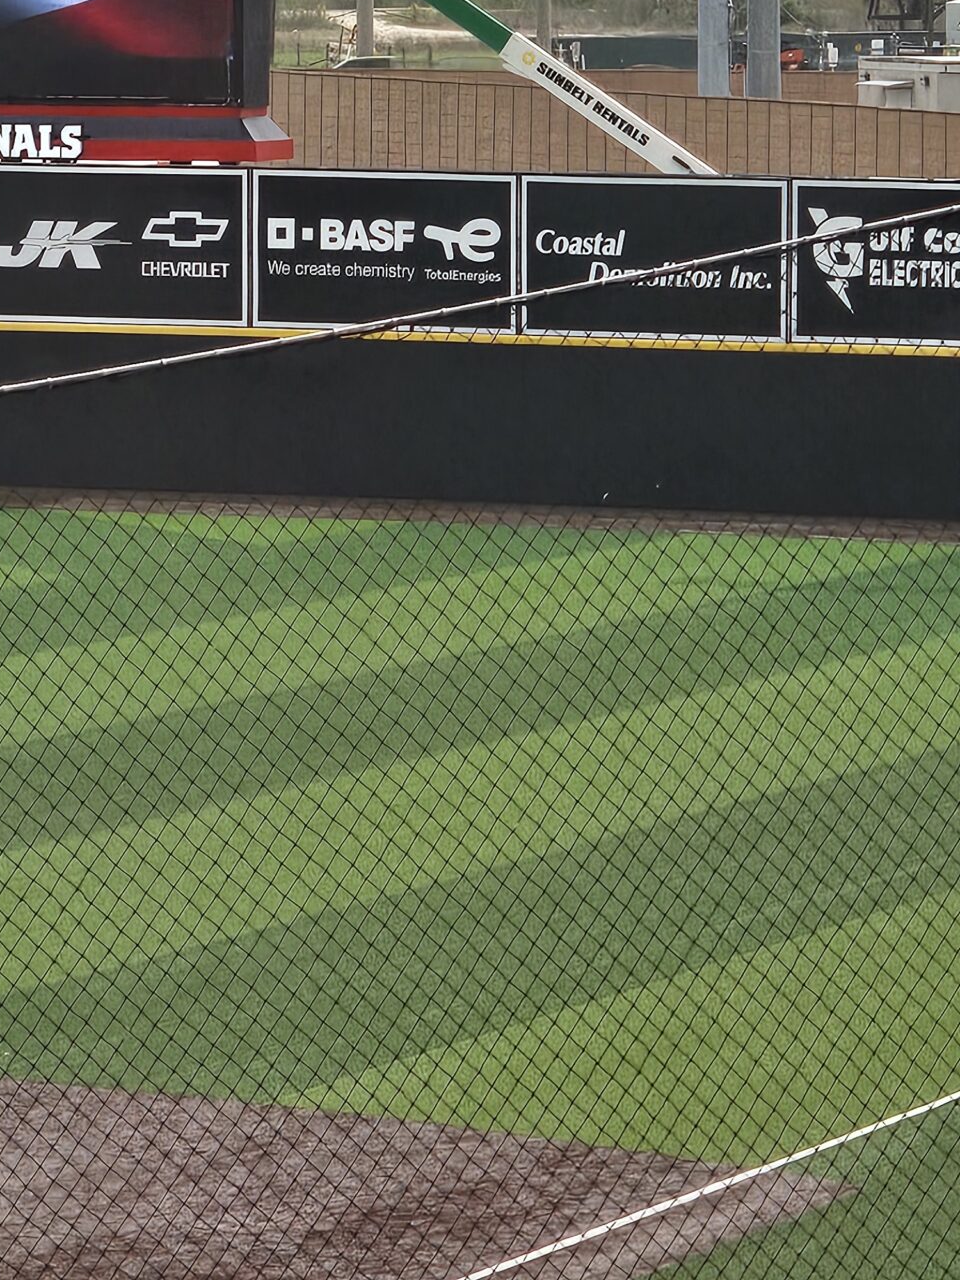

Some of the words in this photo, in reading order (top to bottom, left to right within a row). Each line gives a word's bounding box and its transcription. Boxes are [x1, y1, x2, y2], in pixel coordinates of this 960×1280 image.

[536, 61, 593, 106] SUNBELT
[591, 100, 650, 147] RENTALS
[320, 218, 416, 252] BASF
[535, 229, 626, 257] Coastal
[141, 261, 230, 278] CHEVROLET
[267, 260, 291, 276] We
[294, 262, 341, 278] create
[345, 262, 415, 281] chemistry
[424, 269, 502, 284] TotalEnergies
[729, 265, 772, 289] Inc.
